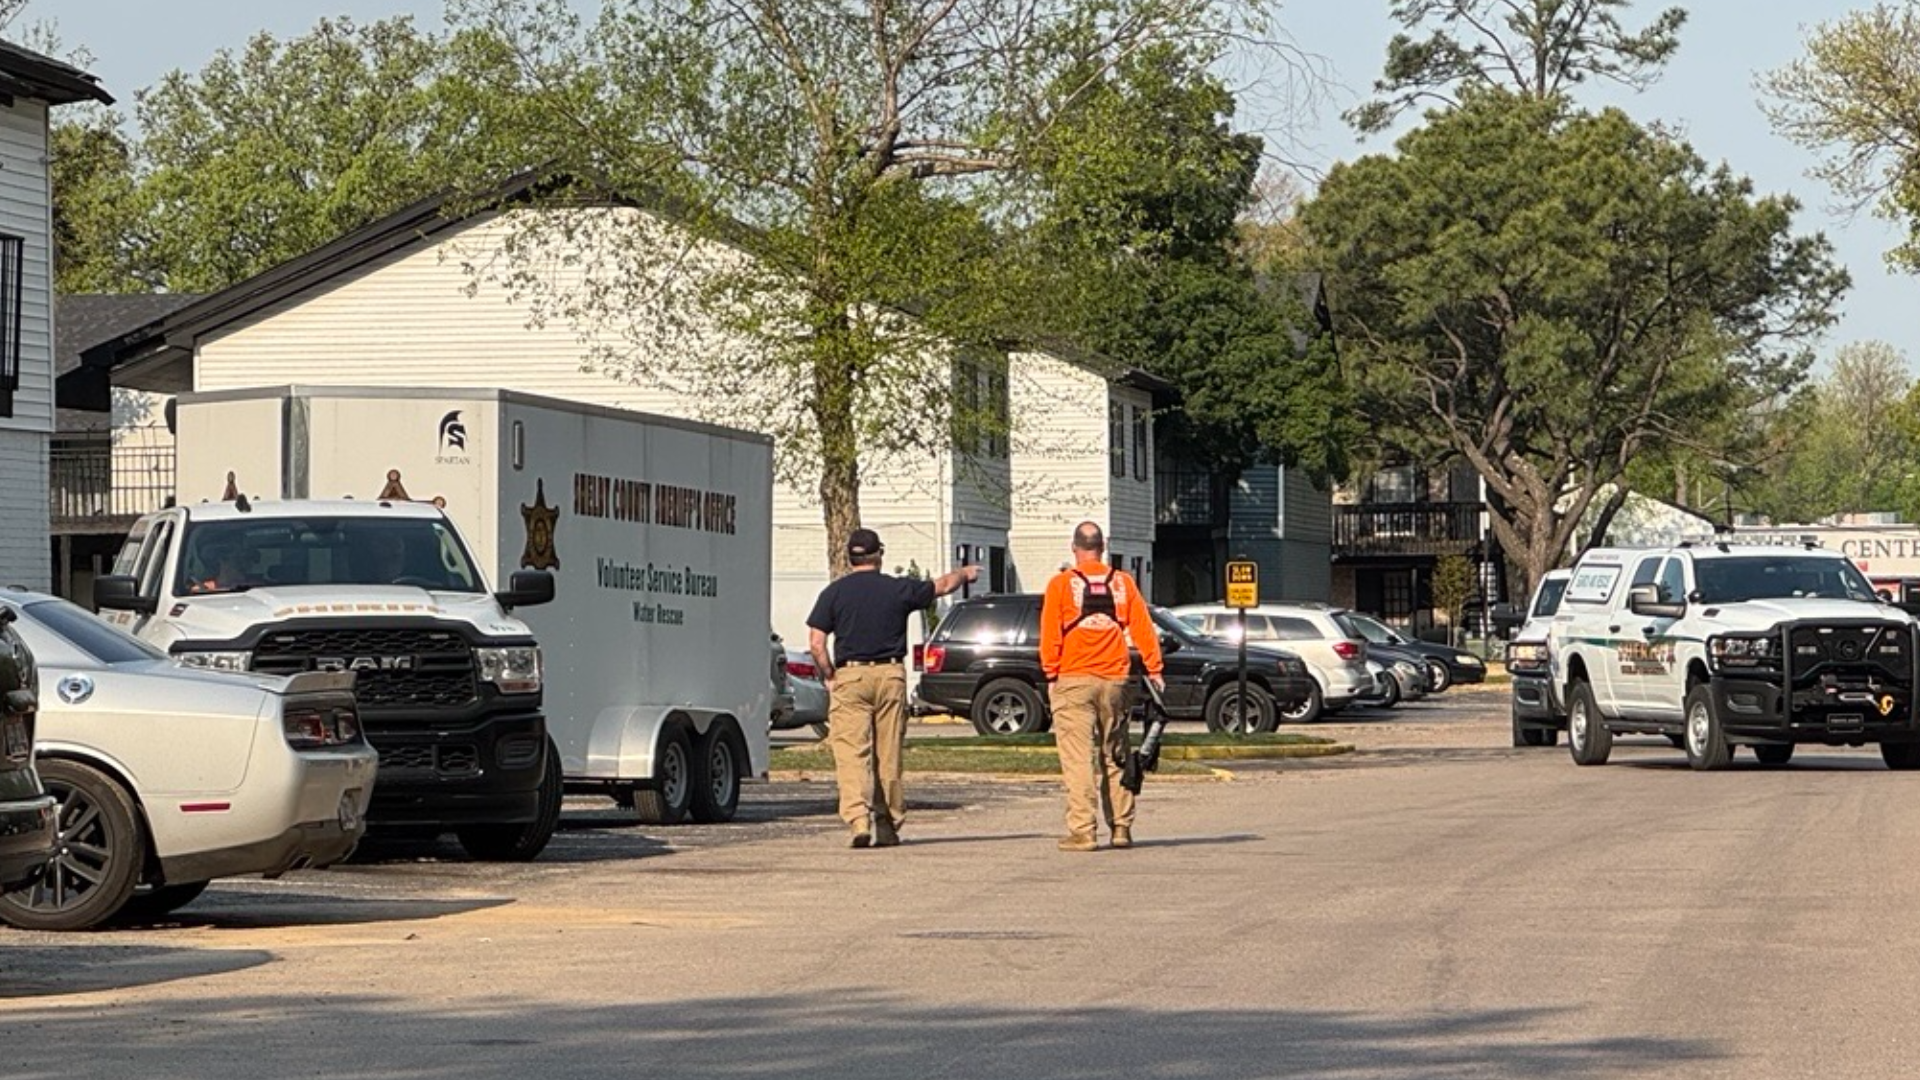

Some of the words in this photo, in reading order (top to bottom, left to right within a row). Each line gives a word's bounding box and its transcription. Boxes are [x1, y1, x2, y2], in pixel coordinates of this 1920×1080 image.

[434, 456, 470, 465] SPARTAN
[613, 477, 651, 524] COUNTY
[703, 490, 736, 536] OFFICE
[597, 556, 645, 592] Volunteer
[647, 562, 682, 595] Service
[685, 565, 718, 598] Bureau
[633, 601, 655, 623] Water
[657, 603, 684, 626] Rescue
[315, 656, 411, 671] RAM
